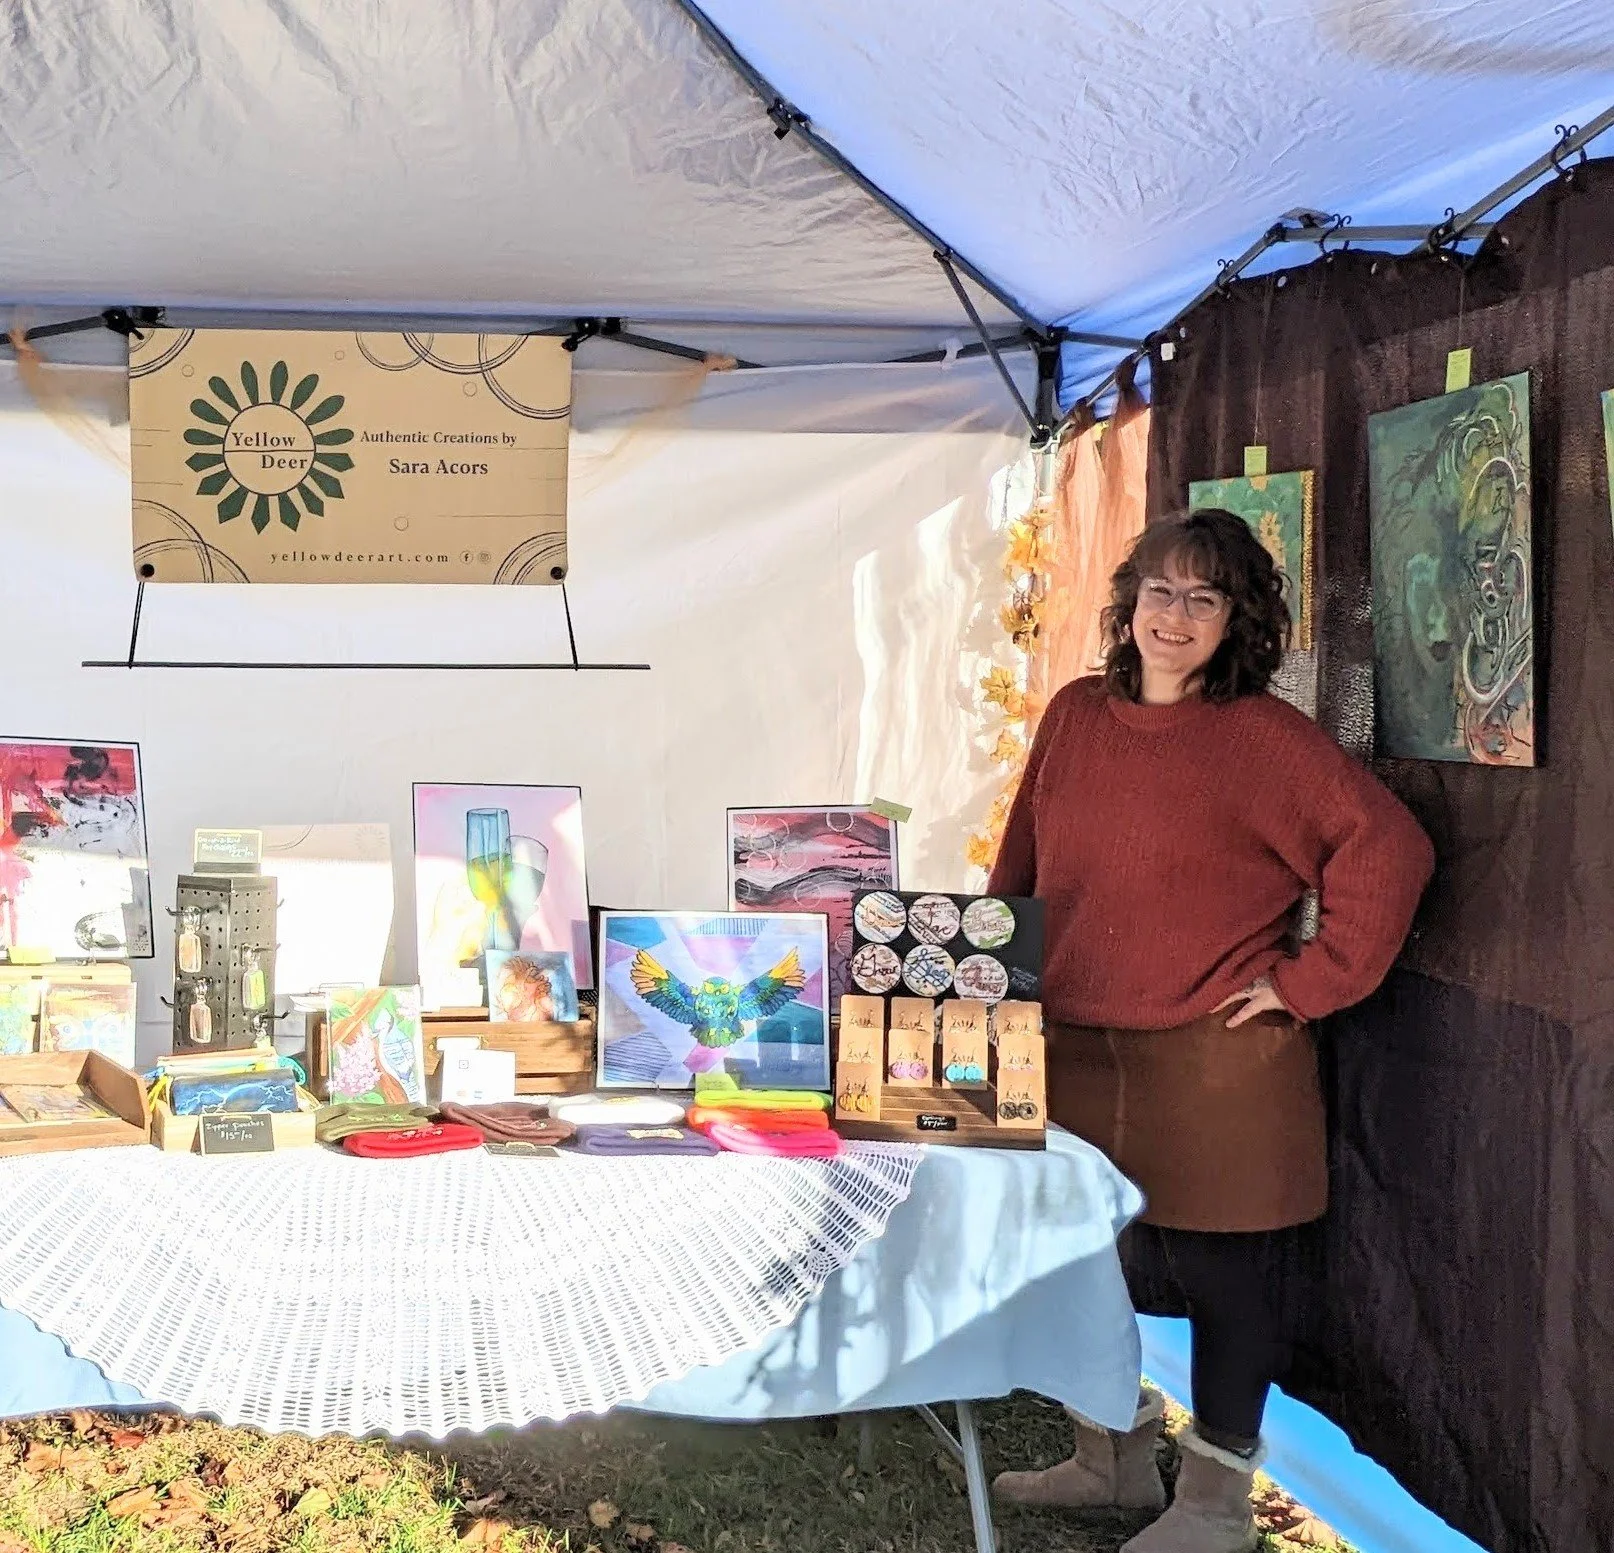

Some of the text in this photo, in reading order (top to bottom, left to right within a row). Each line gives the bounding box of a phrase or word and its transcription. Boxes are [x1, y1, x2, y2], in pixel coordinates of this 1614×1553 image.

[232, 431, 296, 447] Yellow
[360, 431, 517, 448] Authentic Creations by
[261, 454, 308, 469] Deer
[389, 458, 489, 475] Sara Acors
[269, 550, 449, 564] yellowdeerart.com
